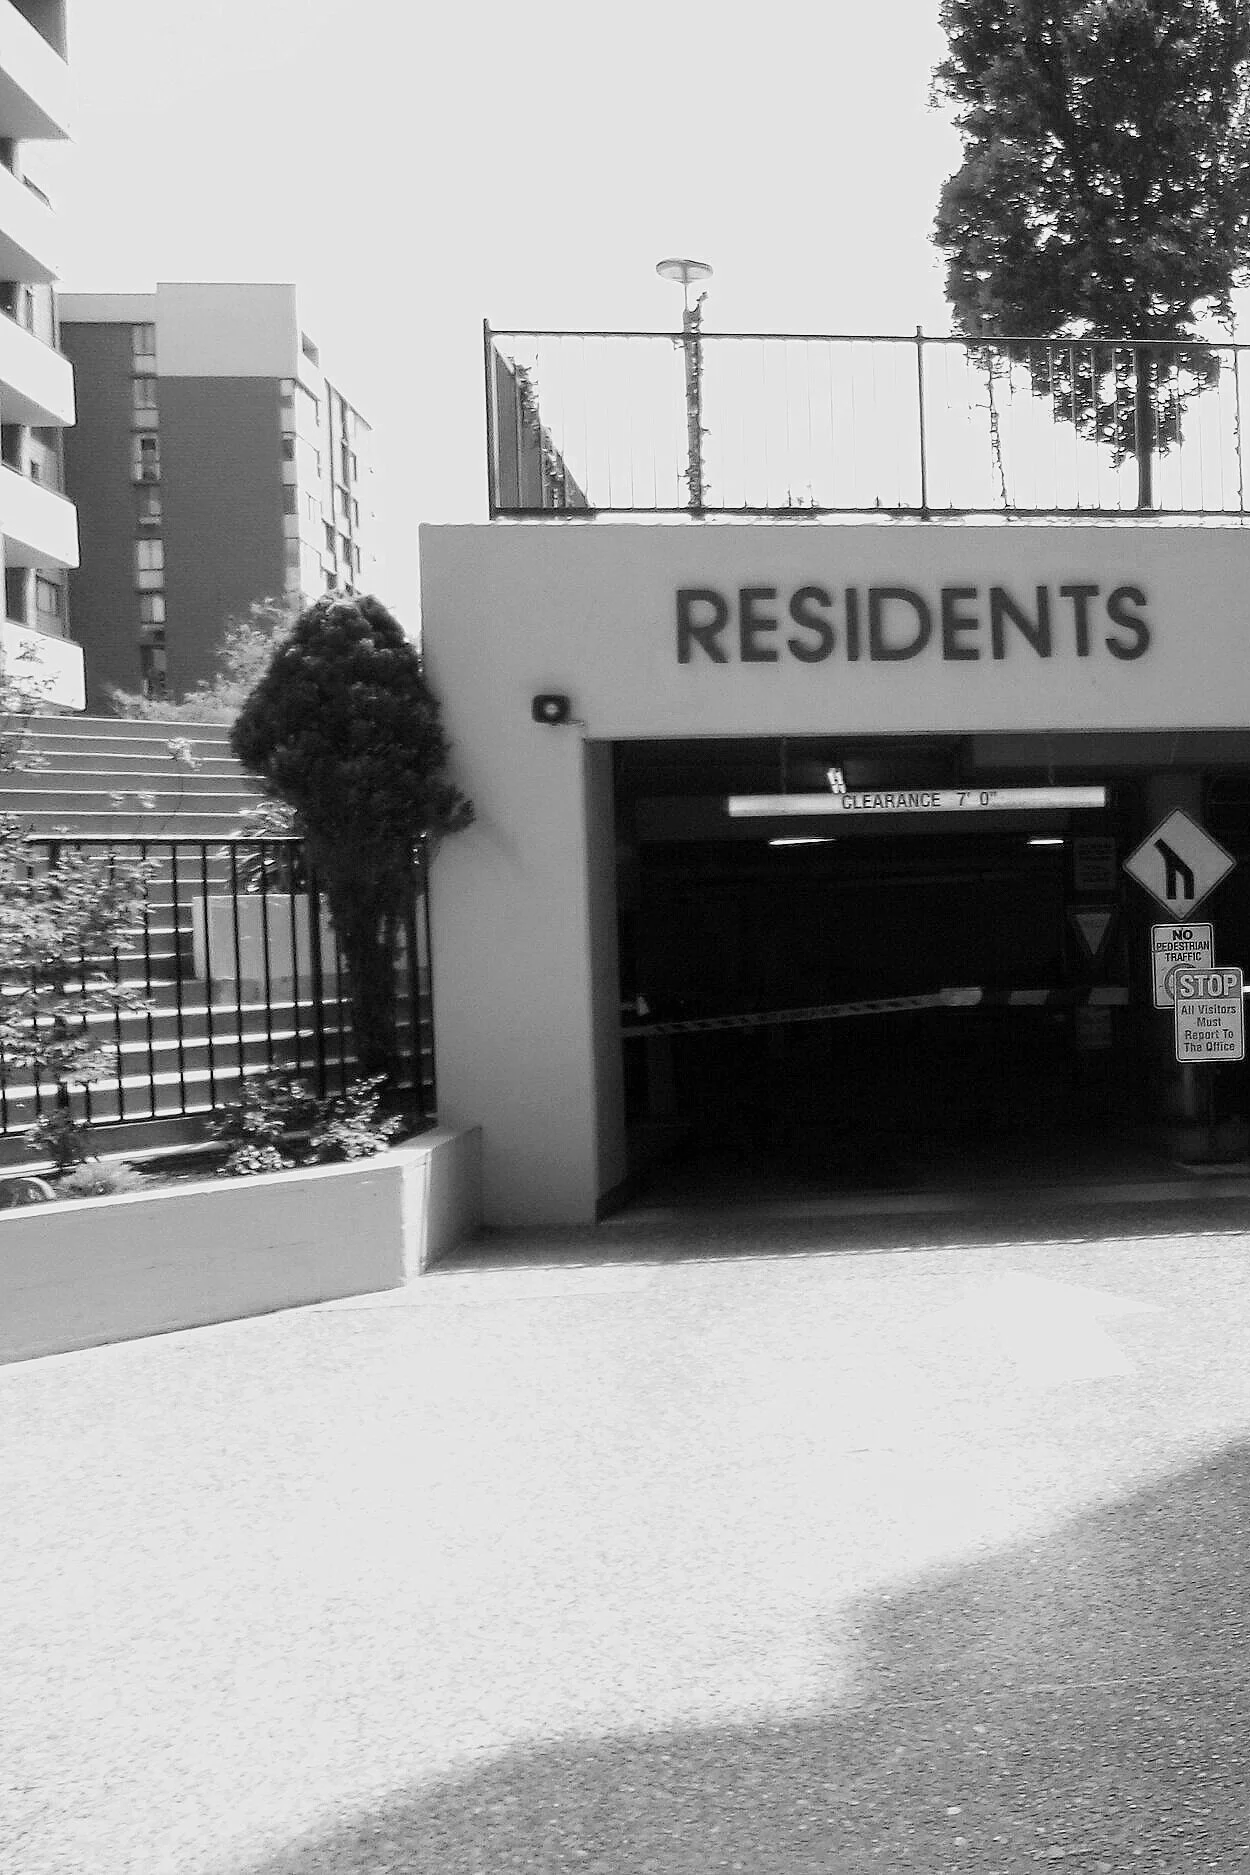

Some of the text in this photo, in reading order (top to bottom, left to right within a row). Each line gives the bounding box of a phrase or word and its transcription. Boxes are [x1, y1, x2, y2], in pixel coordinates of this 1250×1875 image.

[676, 586, 1151, 664] RESIDENTS
[842, 793, 941, 809] CLEARANCE
[956, 791, 970, 807] 7'
[1172, 929, 1193, 941] NO
[1156, 941, 1210, 951] PEDESTRIAN
[1165, 952, 1202, 962] TRAFFIC
[1180, 974, 1237, 997] STOP
[1181, 1004, 1237, 1015] All Visitors
[1197, 1017, 1221, 1027] Must
[1184, 1028, 1234, 1040] Report To
[1184, 1041, 1235, 1052] The Office
